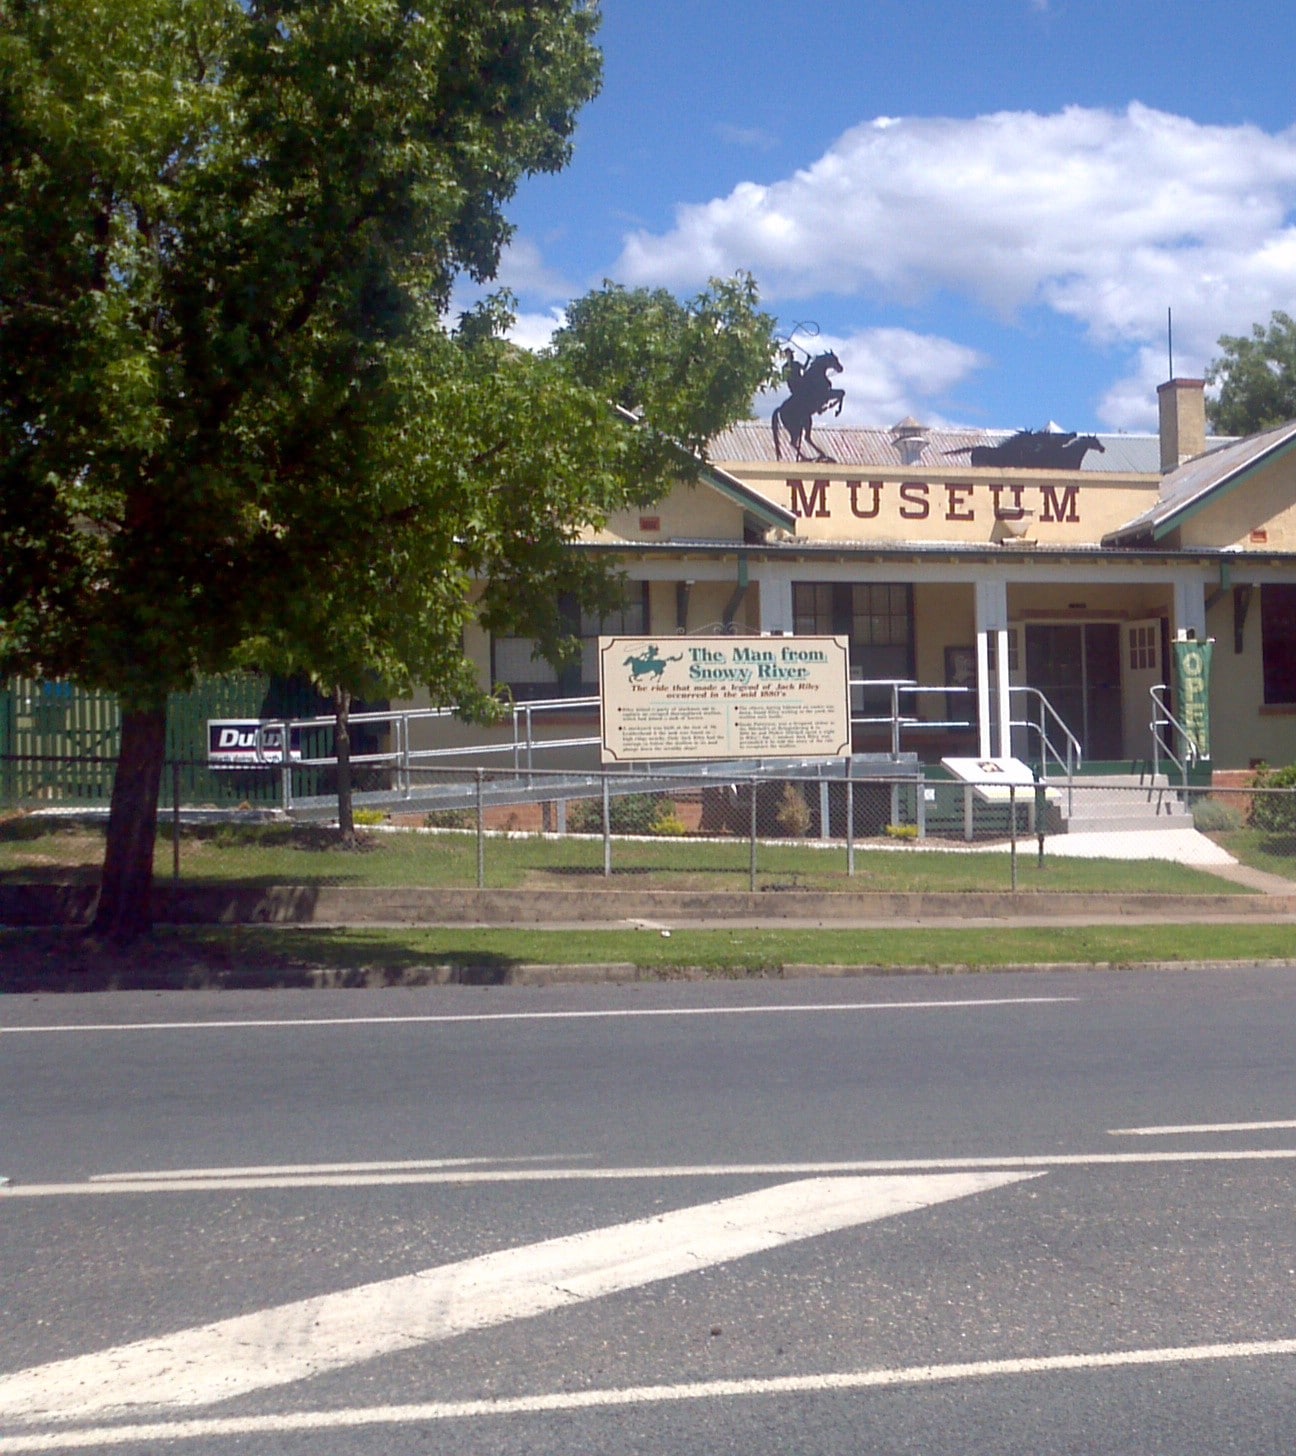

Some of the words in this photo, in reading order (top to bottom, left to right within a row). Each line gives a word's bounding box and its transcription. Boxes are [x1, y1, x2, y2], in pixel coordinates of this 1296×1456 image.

[786, 479, 1080, 522] MUSEUM
[689, 647, 725, 664] The
[733, 647, 775, 664] Man
[781, 646, 827, 663] from
[689, 664, 752, 684] Snowy
[758, 663, 809, 680] River
[731, 684, 759, 692] legend
[798, 683, 819, 691] Riley
[1183, 652, 1206, 755] OPEN
